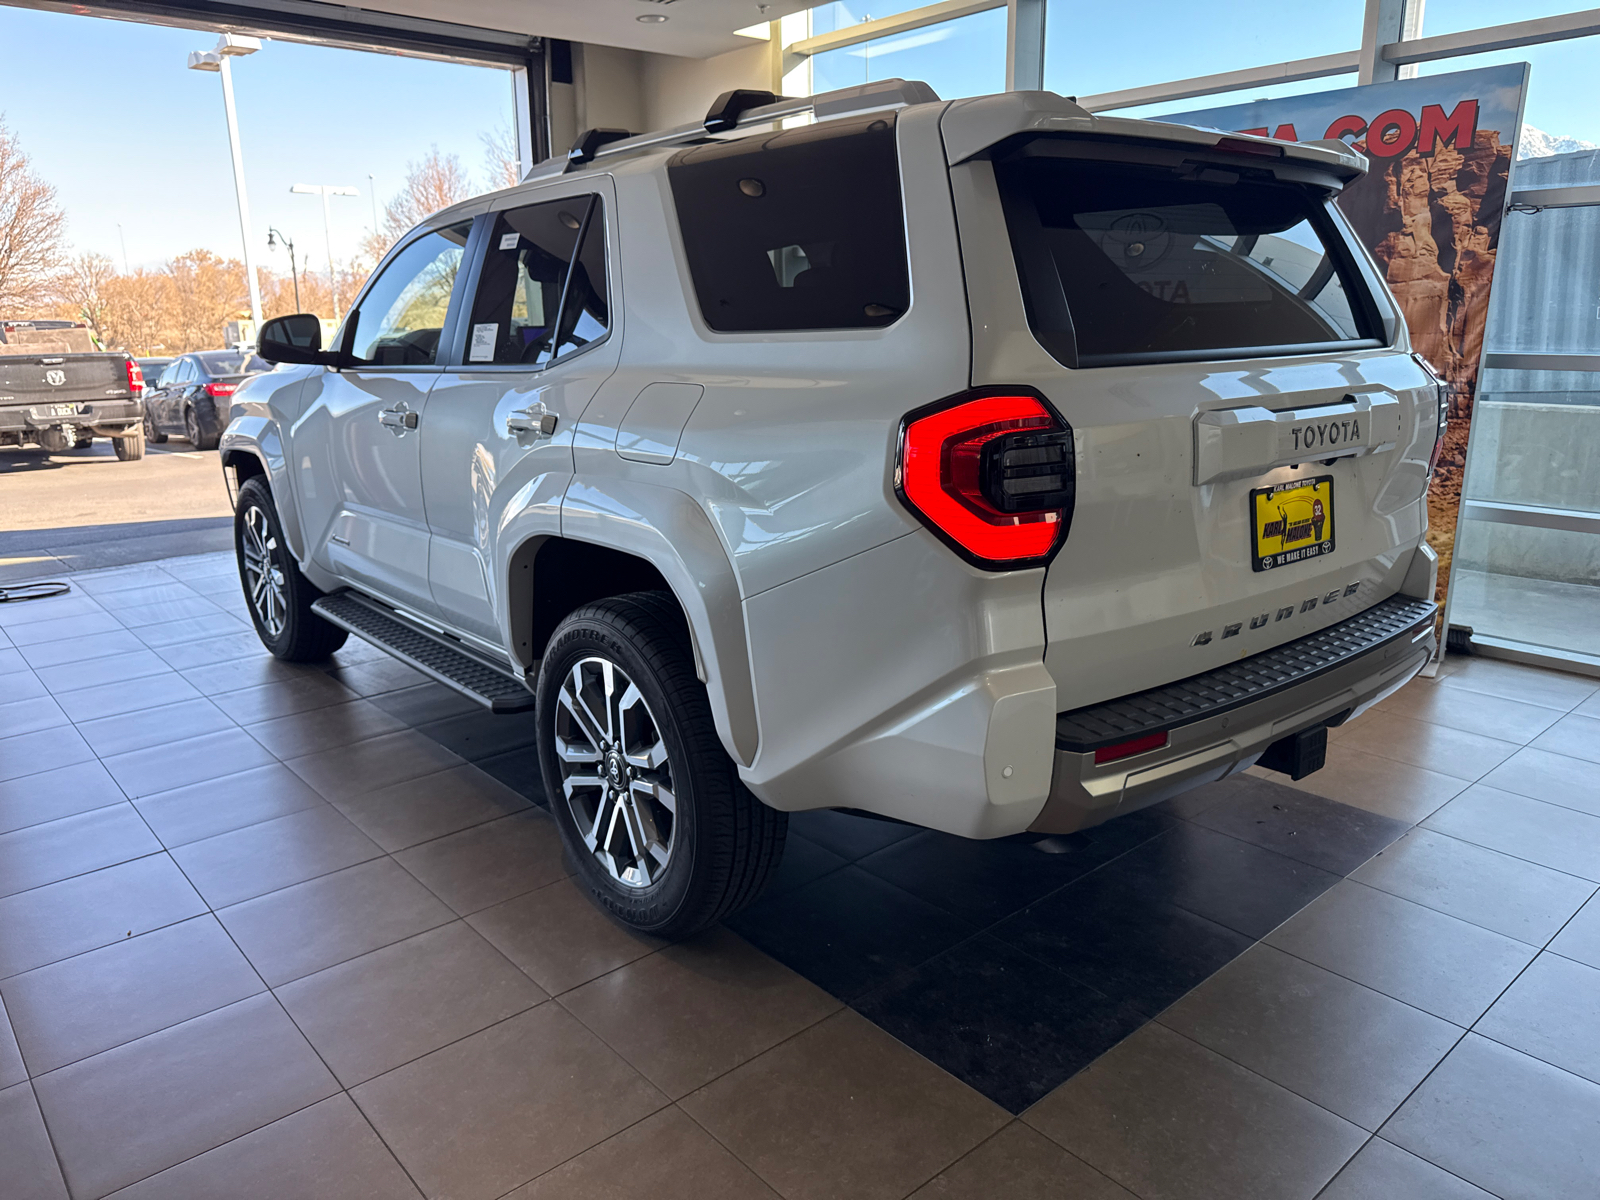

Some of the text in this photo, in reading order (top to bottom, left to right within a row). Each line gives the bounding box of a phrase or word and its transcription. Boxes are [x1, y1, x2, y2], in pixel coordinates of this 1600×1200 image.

[1235, 99, 1480, 158] COM
[1292, 419, 1360, 450] TOYOTA
[1273, 484, 1284, 493] KARL
[1314, 505, 1322, 515] 32
[1277, 546, 1319, 565] WE MAKE IT EASY
